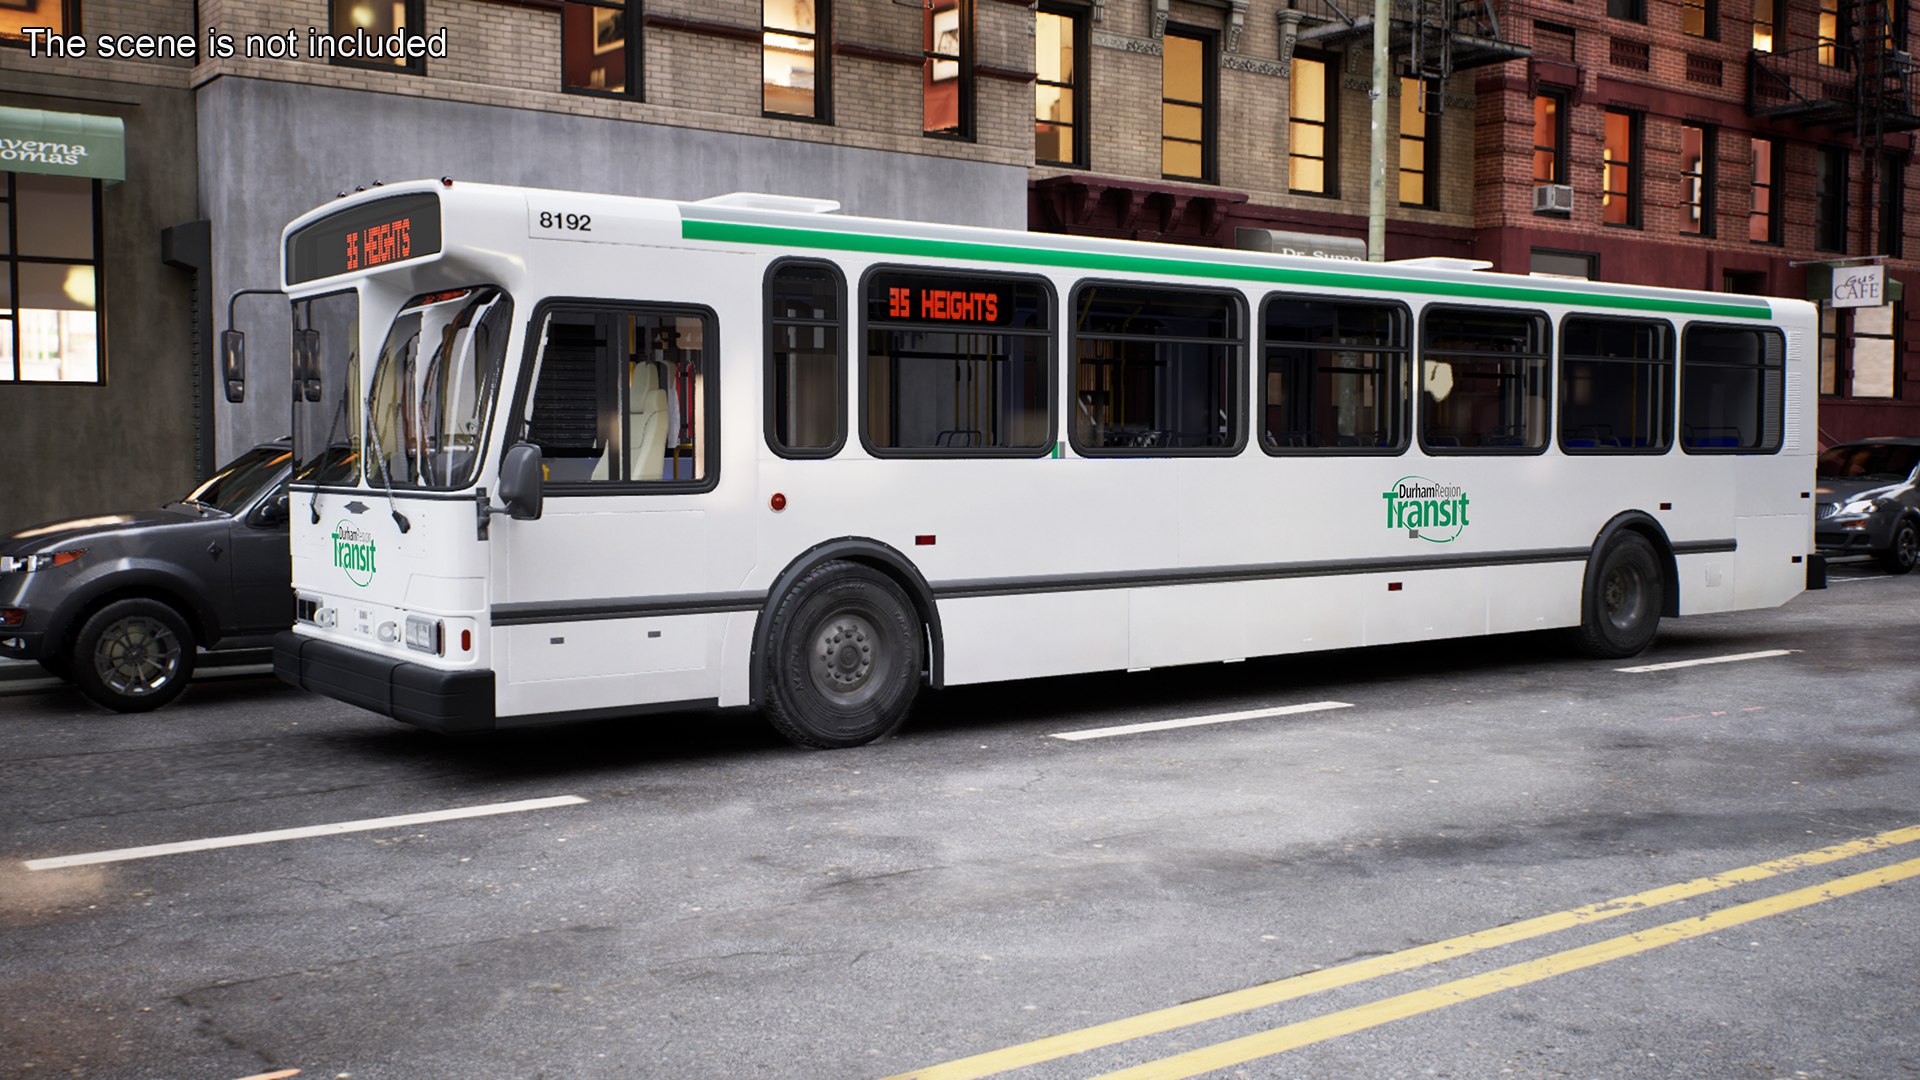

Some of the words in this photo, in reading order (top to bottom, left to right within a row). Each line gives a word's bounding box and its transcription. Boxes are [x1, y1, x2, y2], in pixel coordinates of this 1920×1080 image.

[540, 211, 591, 231] 8192
[346, 232, 358, 269] 35
[363, 218, 411, 266] HEIGHTS
[1834, 282, 1879, 300] CAFE
[1845, 273, 1875, 287] Gus
[889, 287, 910, 318] 35
[921, 289, 998, 321] HEIGHTS
[1382, 492, 1469, 528] Transit
[331, 533, 376, 573] Transit
